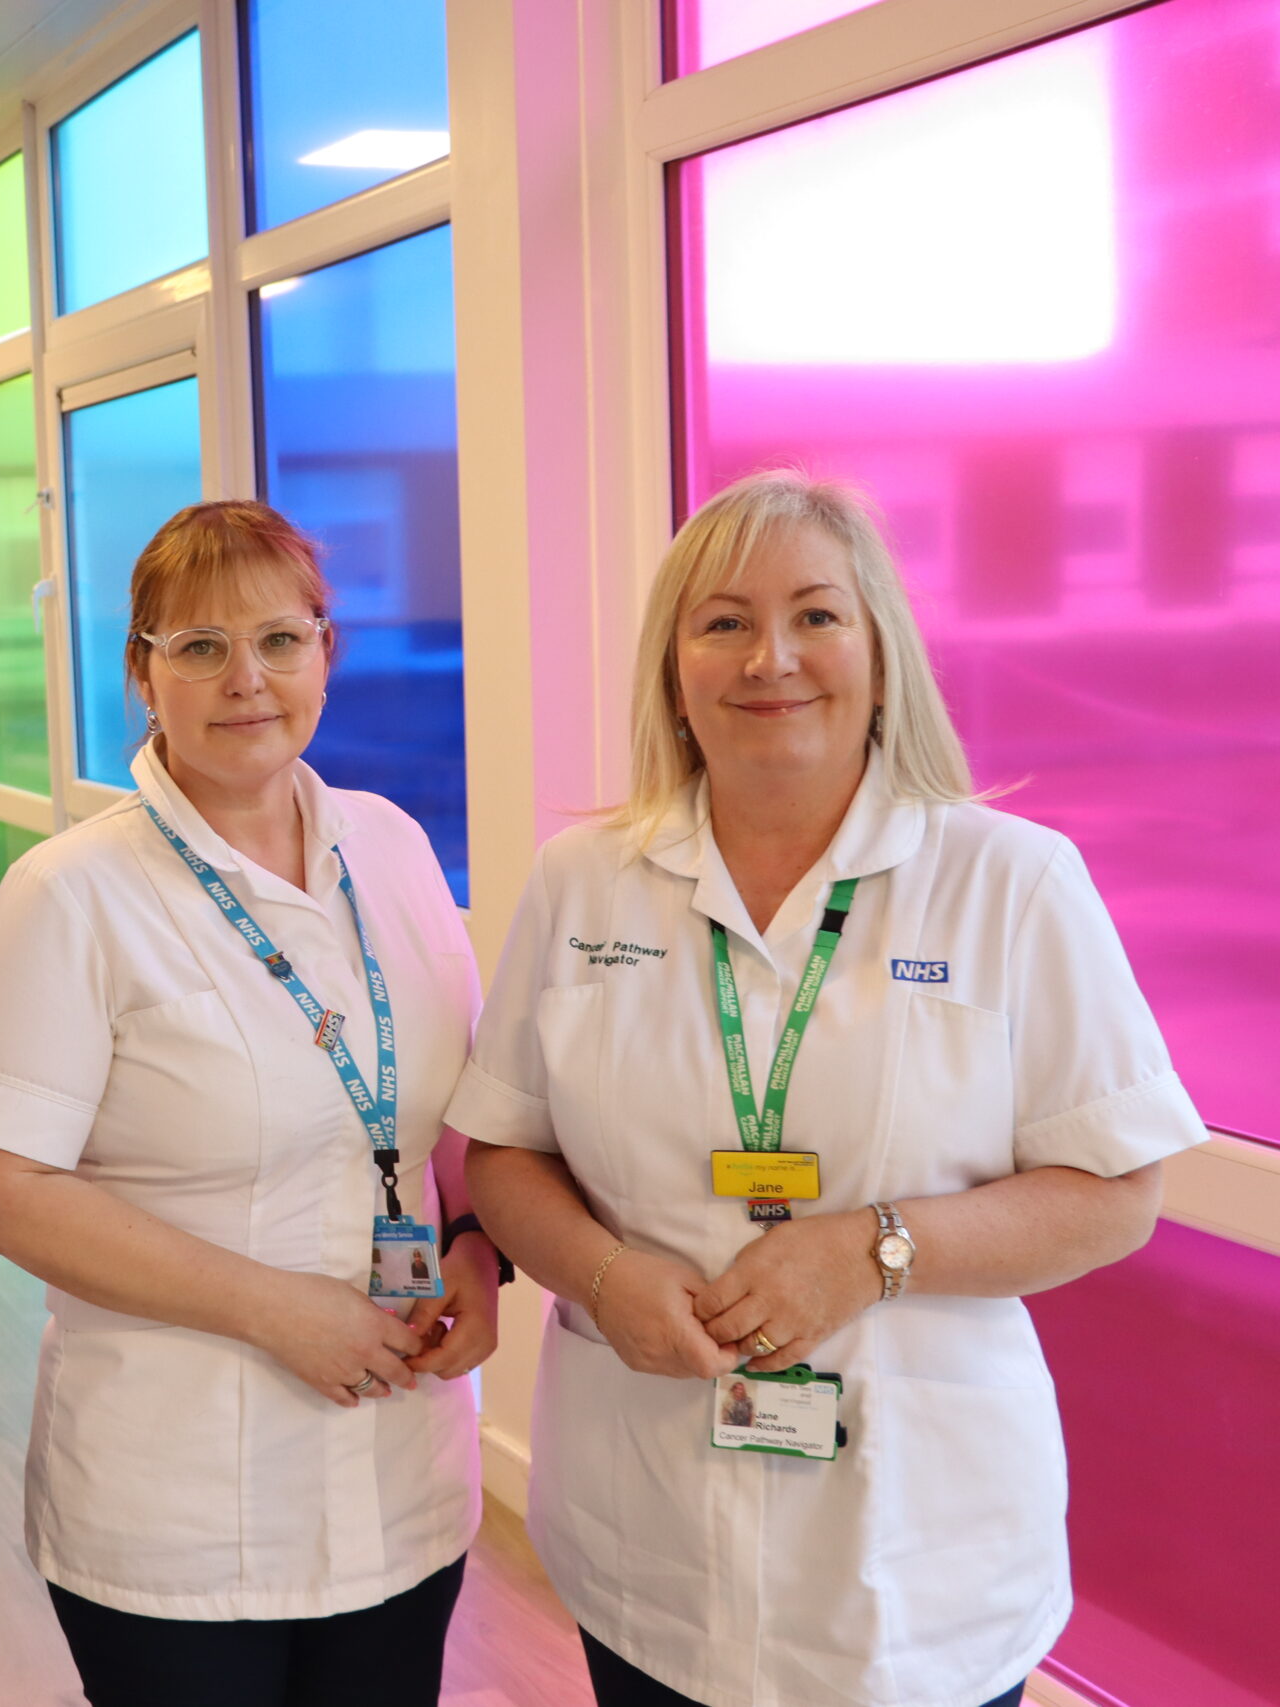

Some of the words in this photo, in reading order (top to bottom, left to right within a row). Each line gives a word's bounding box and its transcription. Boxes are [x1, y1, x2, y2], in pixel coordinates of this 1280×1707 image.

[179, 847, 208, 874] NHS
[207, 881, 237, 910] NHS
[235, 917, 266, 947] NHS
[612, 941, 668, 959] Pathway
[795, 955, 822, 1012] MACMILLAN
[896, 961, 945, 980] NHS
[370, 970, 387, 1003] NHS
[722, 961, 739, 1017] MACMILLAN
[295, 992, 324, 1023] NHS
[320, 1014, 341, 1046] NHS
[379, 1015, 393, 1052] NHS
[332, 1041, 351, 1068] HS
[732, 1033, 751, 1095] MACMILLAN
[770, 1028, 795, 1090] MACMILLAN
[346, 1079, 374, 1112] NHS
[381, 1065, 396, 1102] NHS
[748, 1181, 784, 1193] Jane
[754, 1204, 786, 1217] NHS
[755, 1411, 778, 1420] Jane
[755, 1422, 797, 1434] Richards
[719, 1431, 748, 1441] Cancer
[750, 1435, 783, 1446] Pathway
[785, 1439, 824, 1450] Navigator
